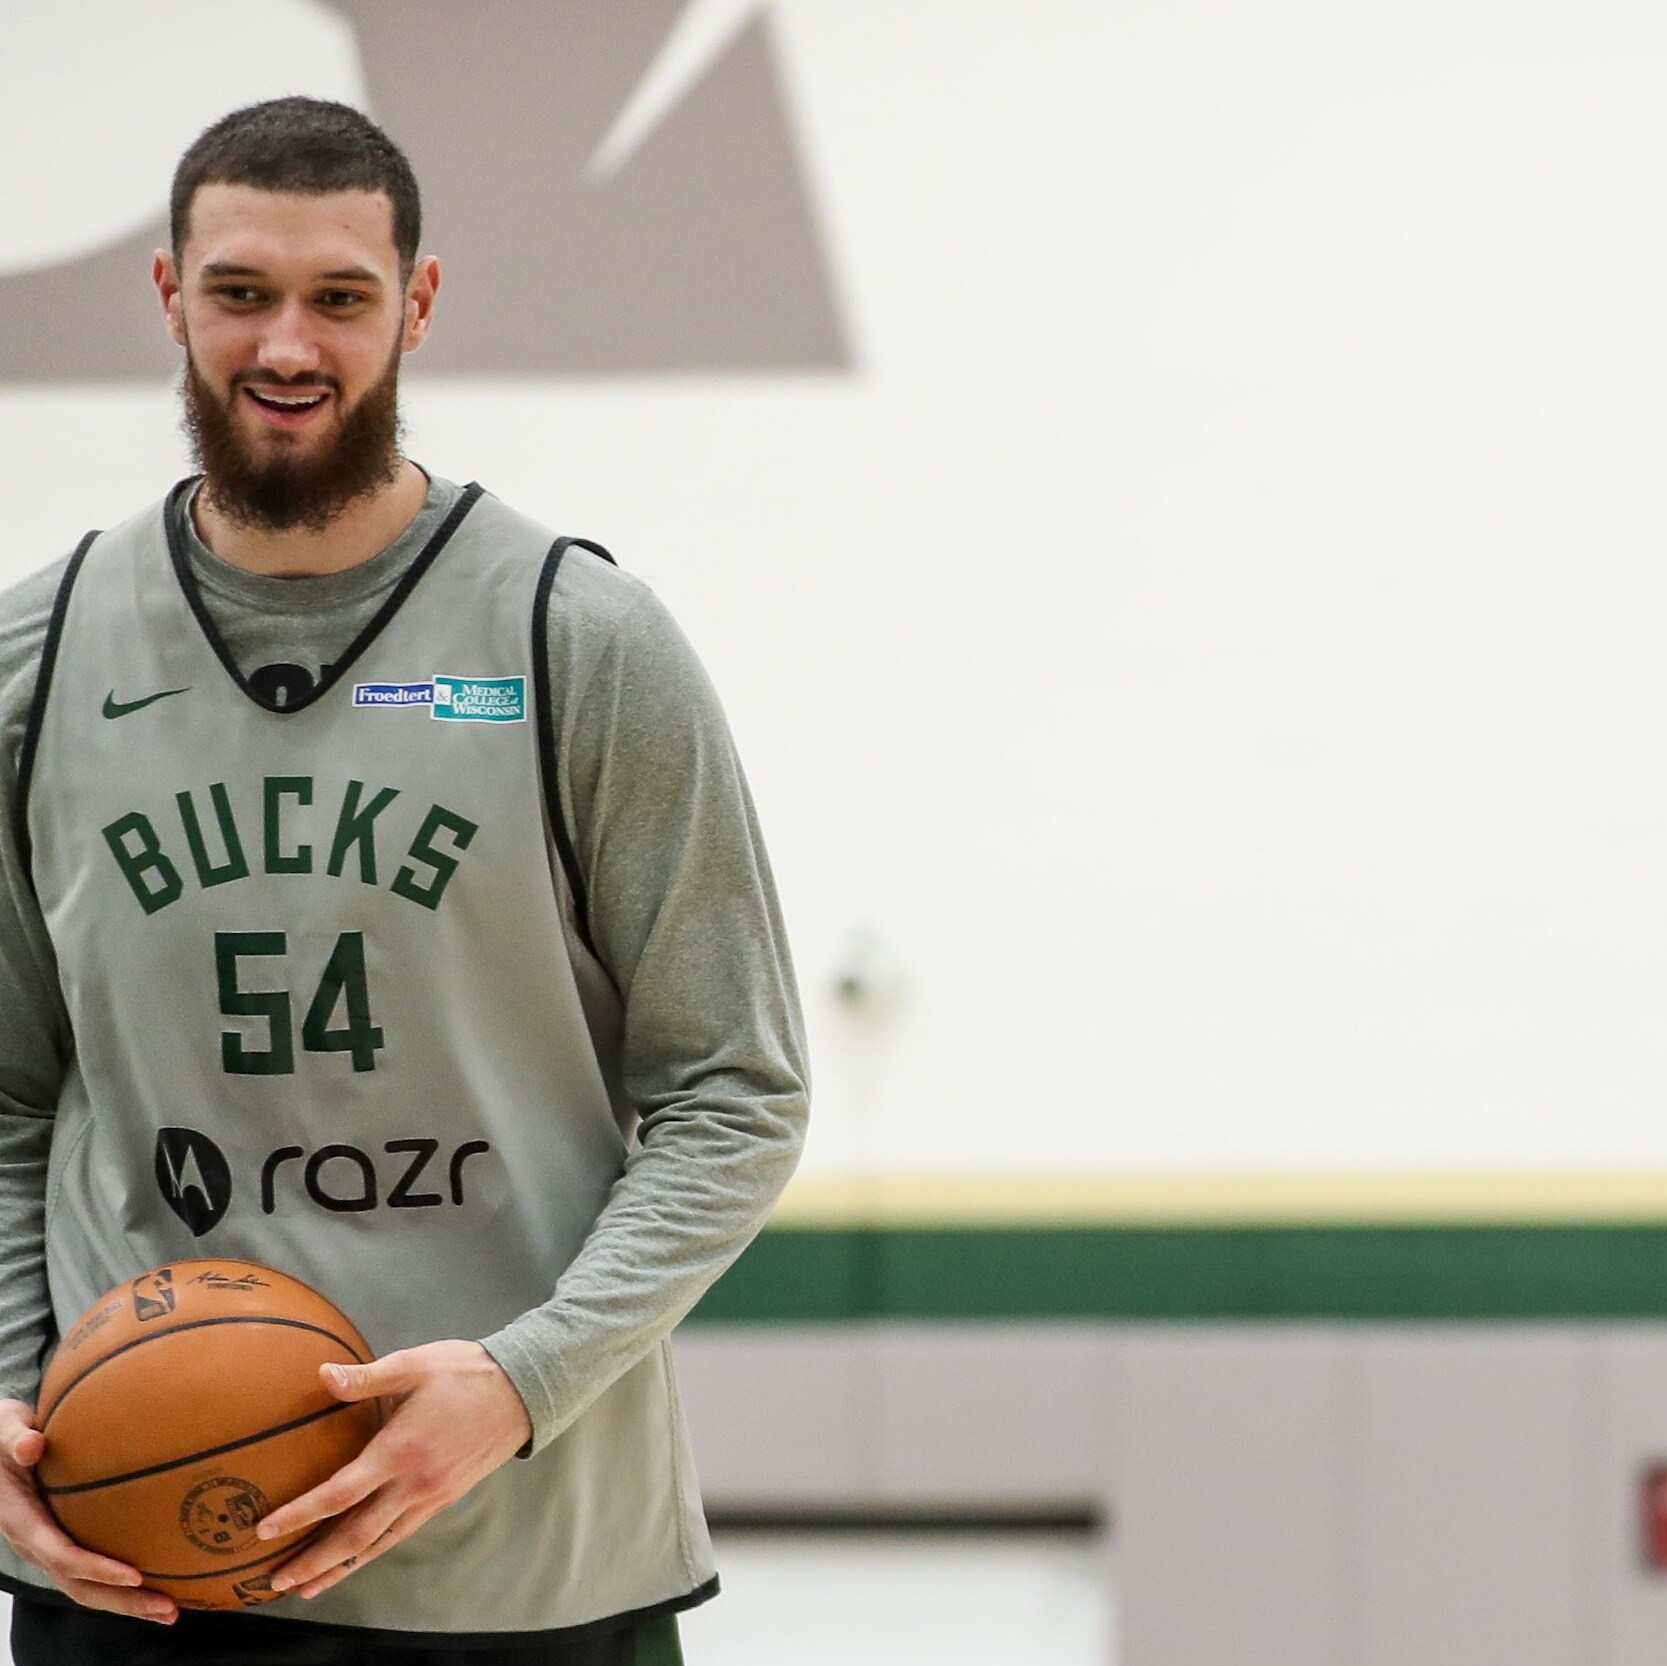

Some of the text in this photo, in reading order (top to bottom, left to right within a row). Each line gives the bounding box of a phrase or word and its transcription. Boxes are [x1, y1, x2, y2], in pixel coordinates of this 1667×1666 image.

[358, 688, 431, 703] Froedtert
[462, 684, 518, 697] MEDICAL
[452, 693, 510, 705] COLLEGE
[452, 703, 522, 717] WISCONSIN
[101, 776, 479, 916] BUCKS
[214, 931, 385, 1076] 54
[260, 1137, 490, 1215] razr
